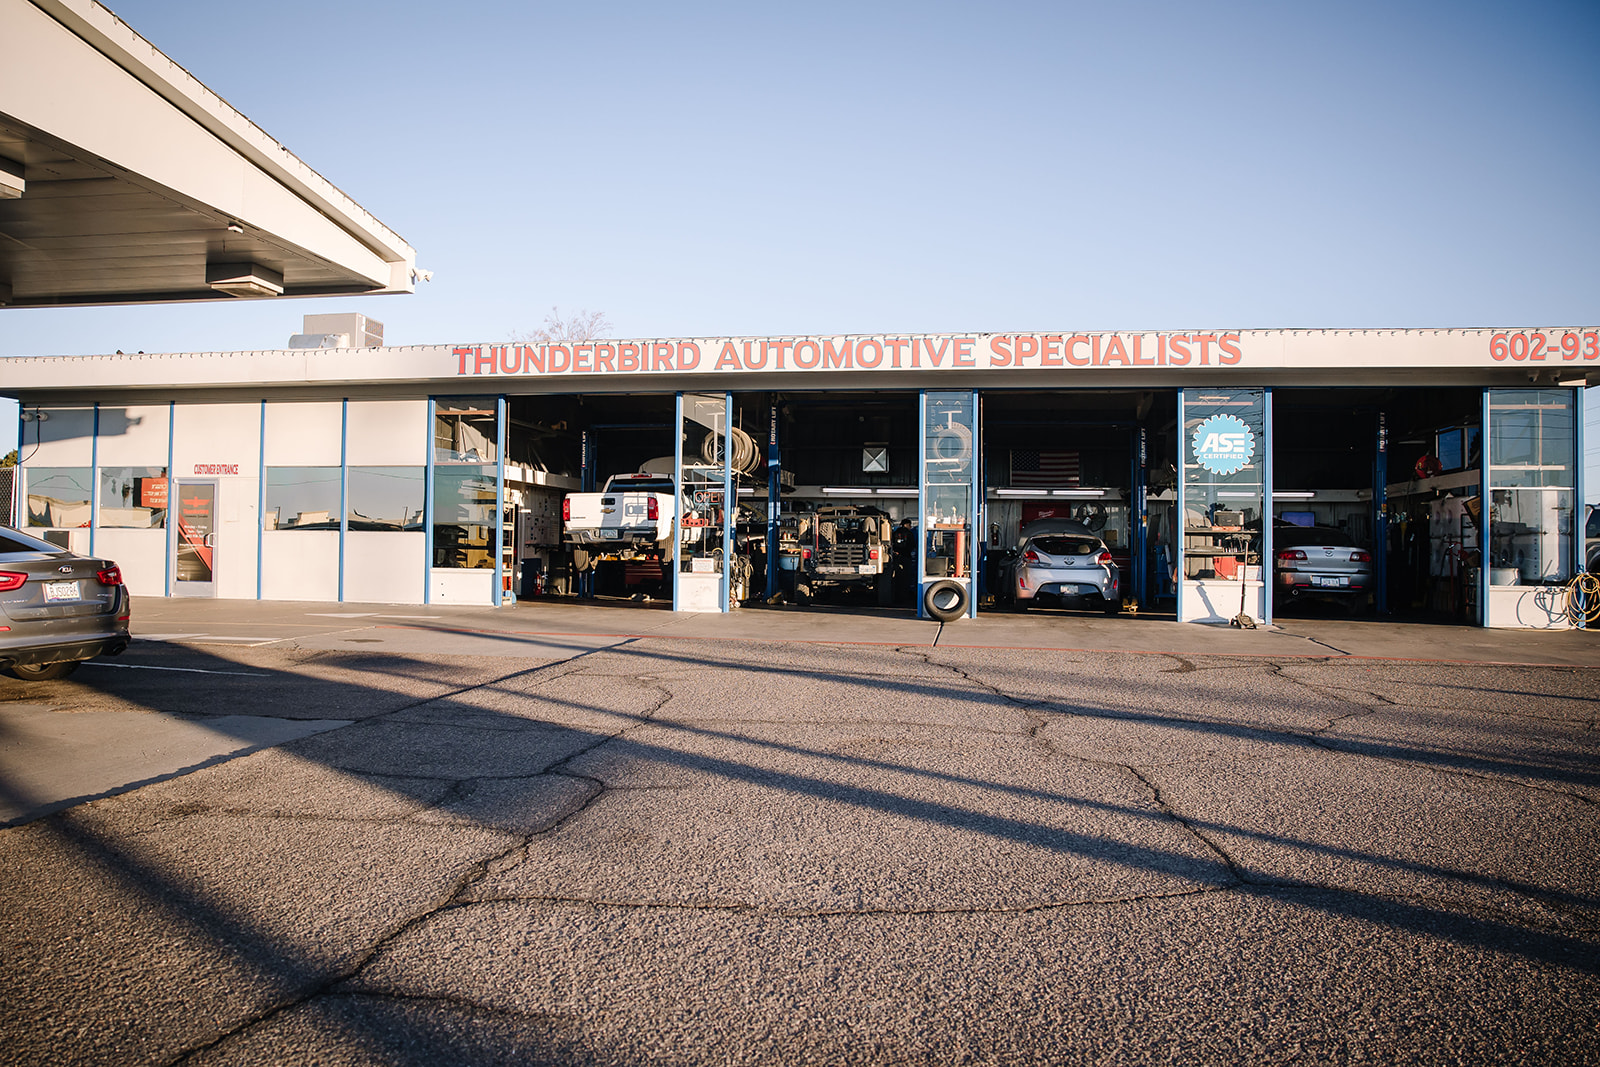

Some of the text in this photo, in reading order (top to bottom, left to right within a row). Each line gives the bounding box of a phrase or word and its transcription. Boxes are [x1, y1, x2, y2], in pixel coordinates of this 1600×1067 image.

[452, 334, 1242, 375] THUNDERBIRD AUTOMOTIVE SPECIALISTS
[1489, 332, 1600, 361] 602-93
[1200, 433, 1245, 453] ASE
[194, 464, 239, 475] CUSTOMER ENTRANCE
